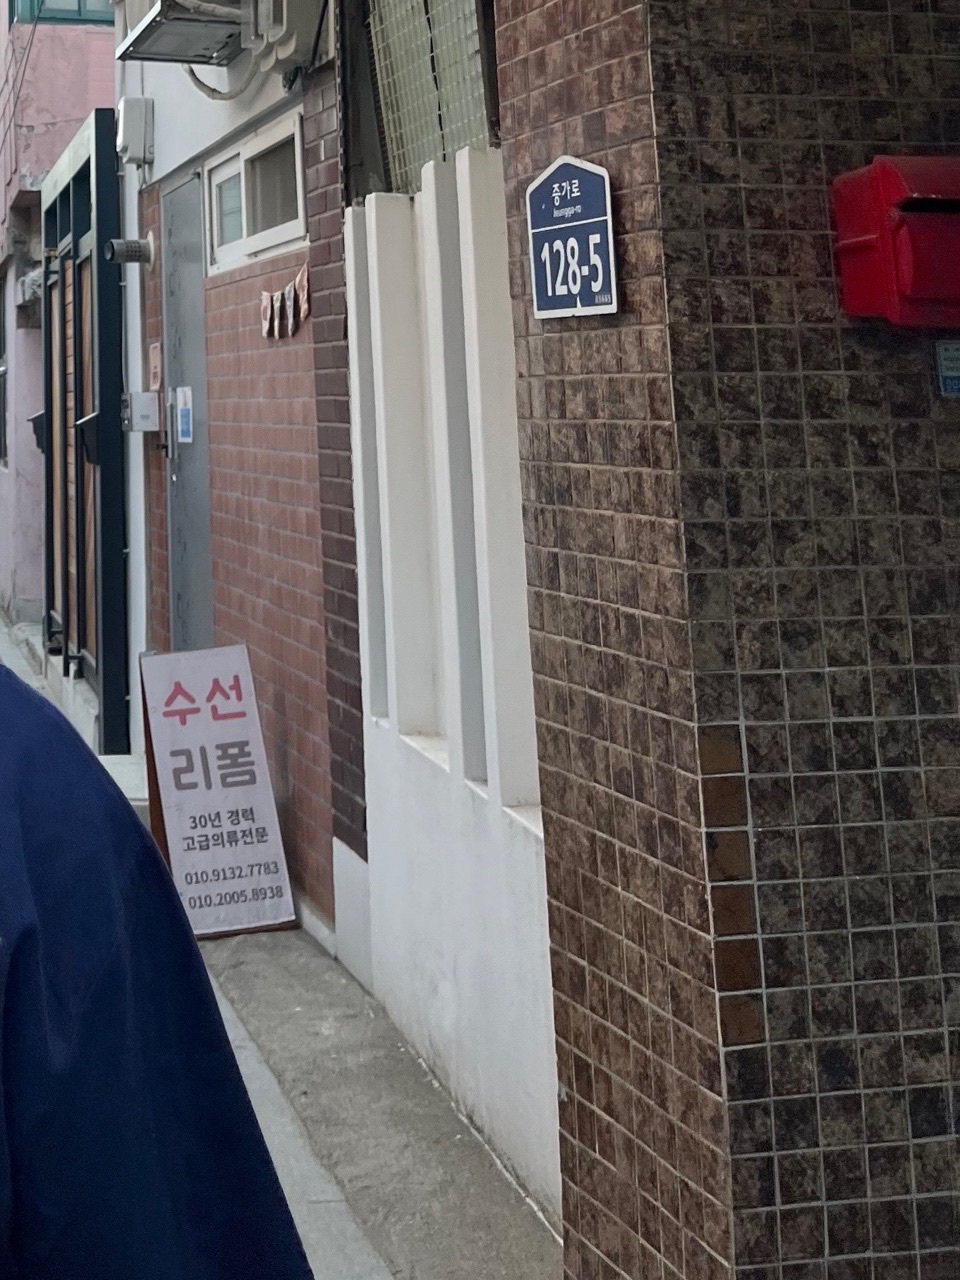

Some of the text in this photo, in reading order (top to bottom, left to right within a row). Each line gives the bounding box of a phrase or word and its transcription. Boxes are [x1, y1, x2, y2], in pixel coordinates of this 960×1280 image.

[551, 179, 581, 206] 증가로
[540, 233, 603, 297] 128-5
[162, 674, 247, 726] 수선
[169, 740, 257, 791] 리폼
[188, 806, 255, 829] 30년 경력
[182, 826, 269, 852] 고급의류전문
[184, 861, 280, 885] 010.9132.7783
[188, 885, 283, 910] 010.2005.8938
